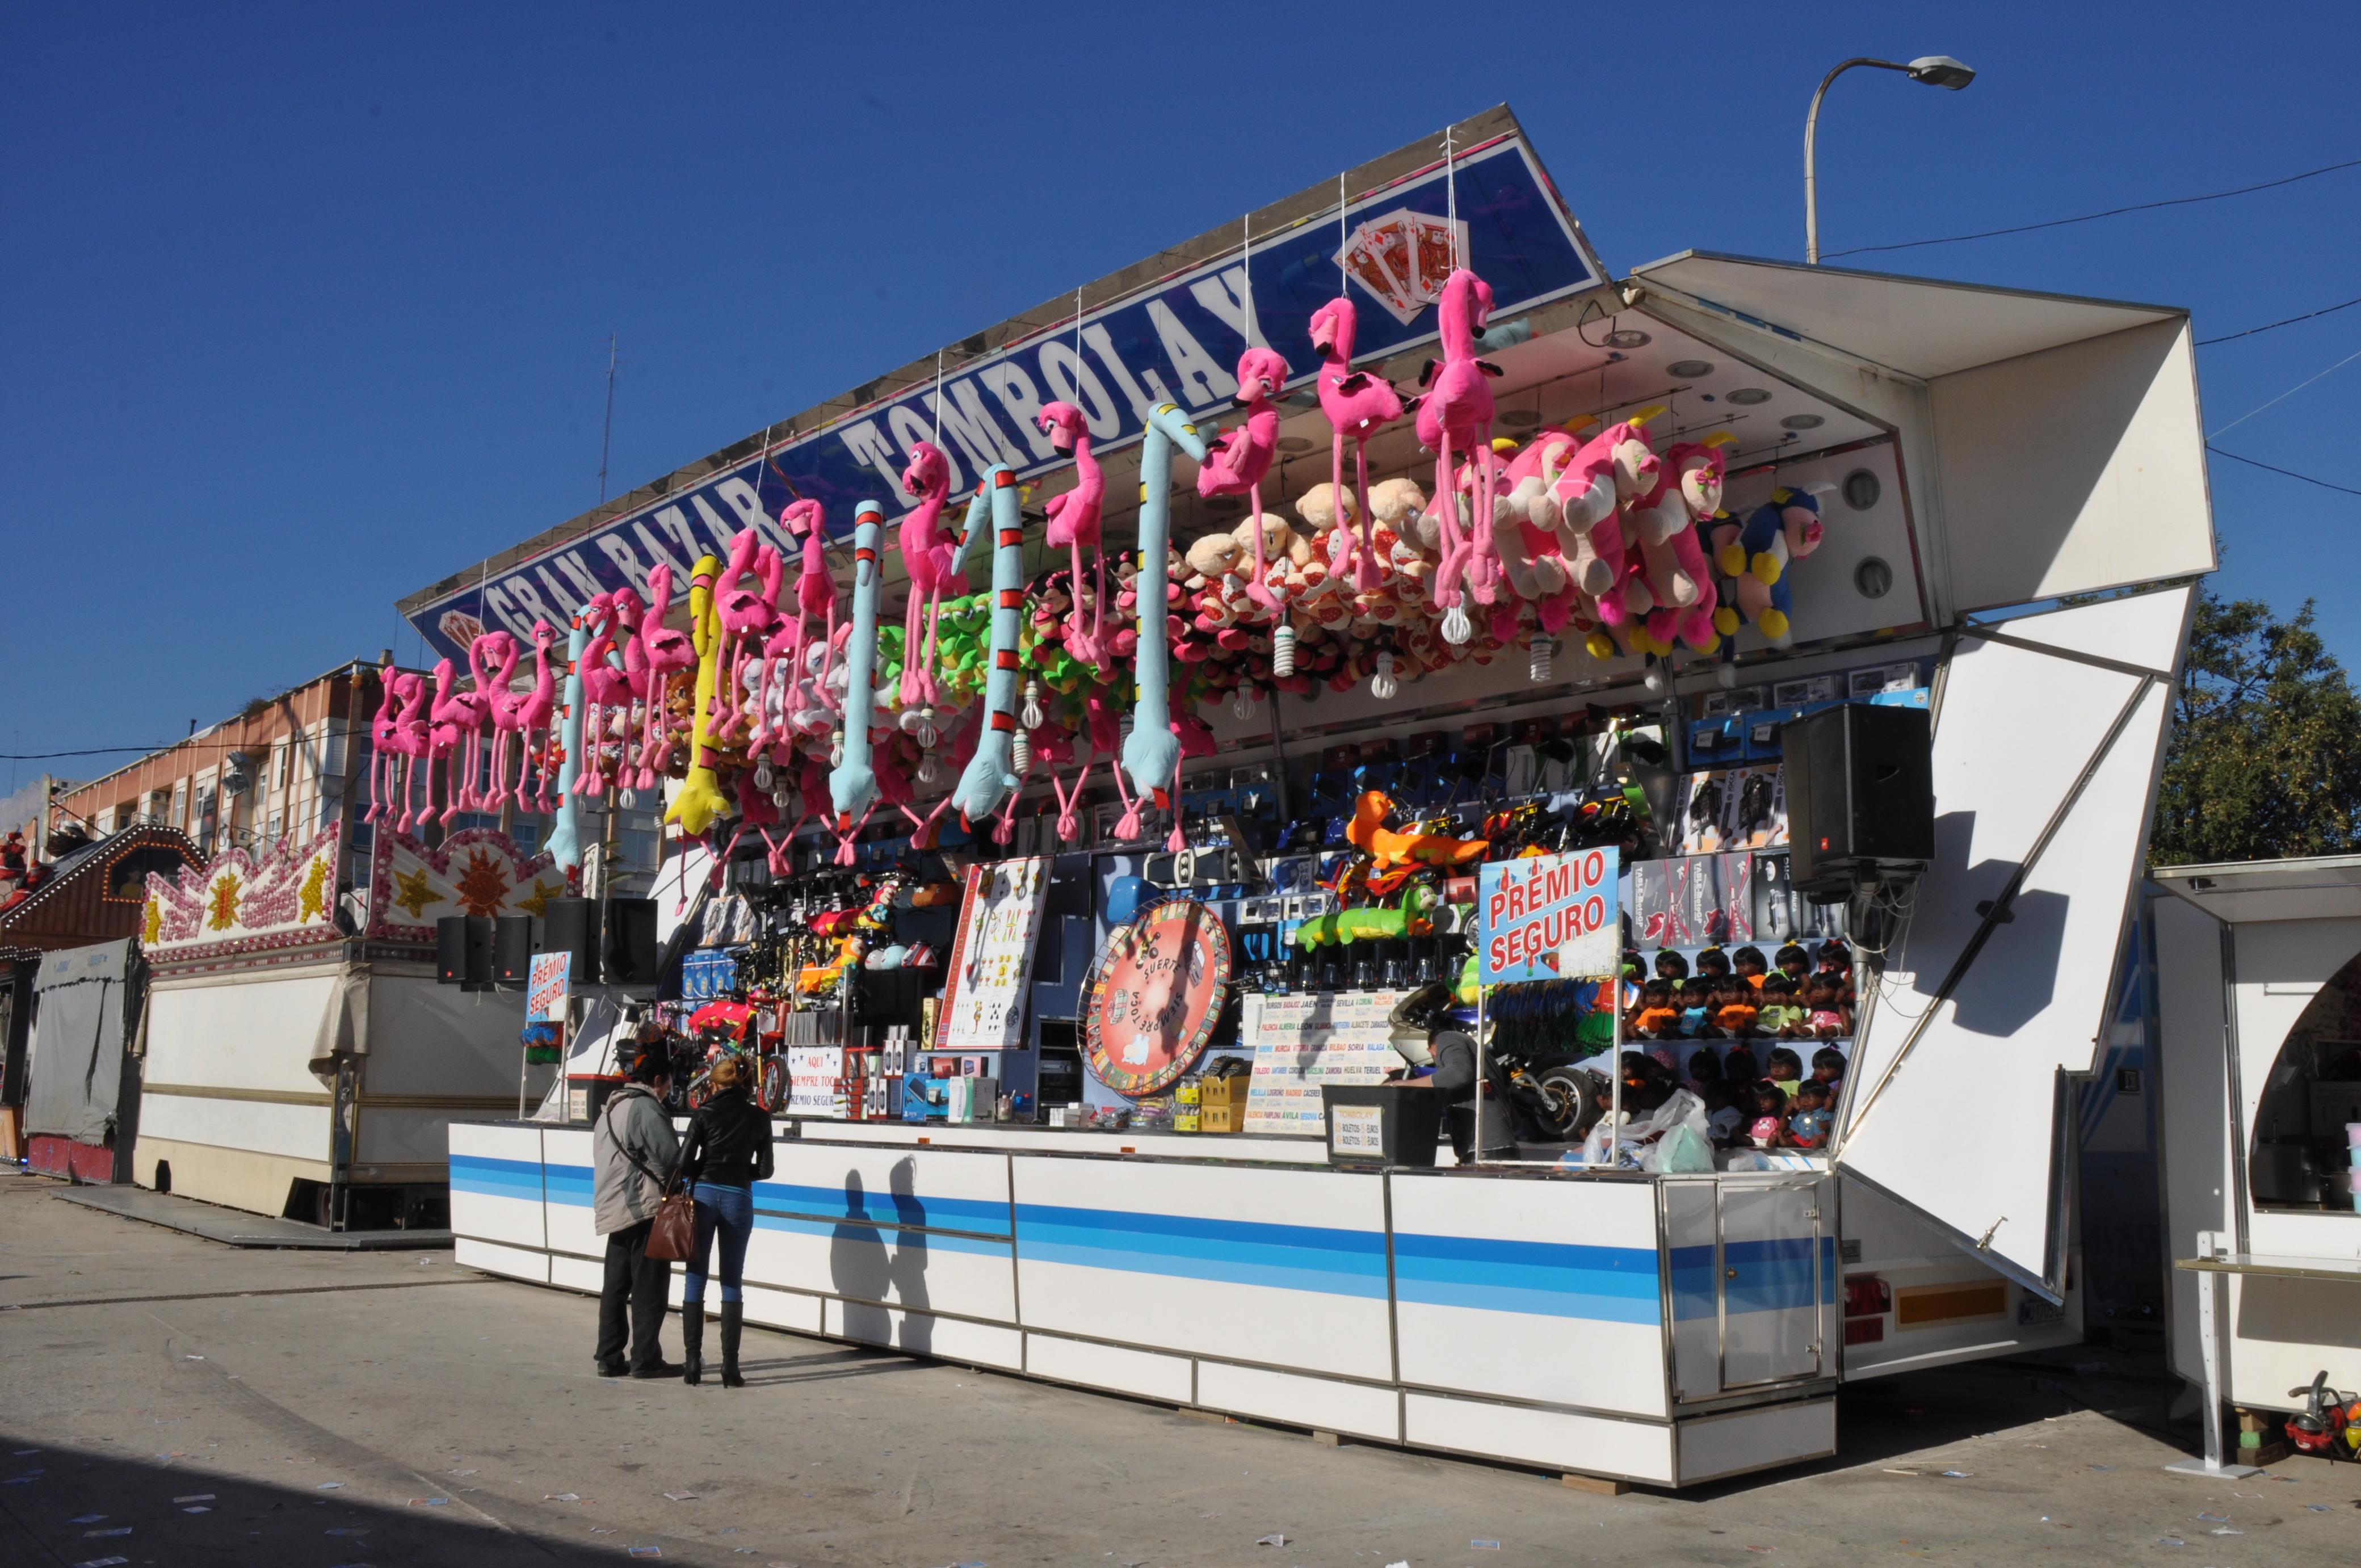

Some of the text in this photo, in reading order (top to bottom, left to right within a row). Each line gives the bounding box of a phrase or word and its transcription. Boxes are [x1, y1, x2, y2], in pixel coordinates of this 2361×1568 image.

[485, 264, 1295, 645] GRAN BAZAR TOMBOLAY
[1490, 850, 1605, 931] PREMIO
[1490, 894, 1605, 974] SEGURO
[531, 953, 567, 991] PREMIO
[1144, 957, 1181, 980] SUERTE
[530, 978, 565, 1015] SEGURO
[1130, 991, 1141, 1024] TOCA
[1300, 999, 1317, 1008] JAÉN
[1336, 999, 1354, 1007] SEVILLA
[808, 1056, 823, 1069] AQUI
[790, 1075, 838, 1087] SIEMPRE TOC
[791, 1095, 834, 1106] REMIO SEGUR
[1282, 1110, 1299, 1119] ÁVILA
